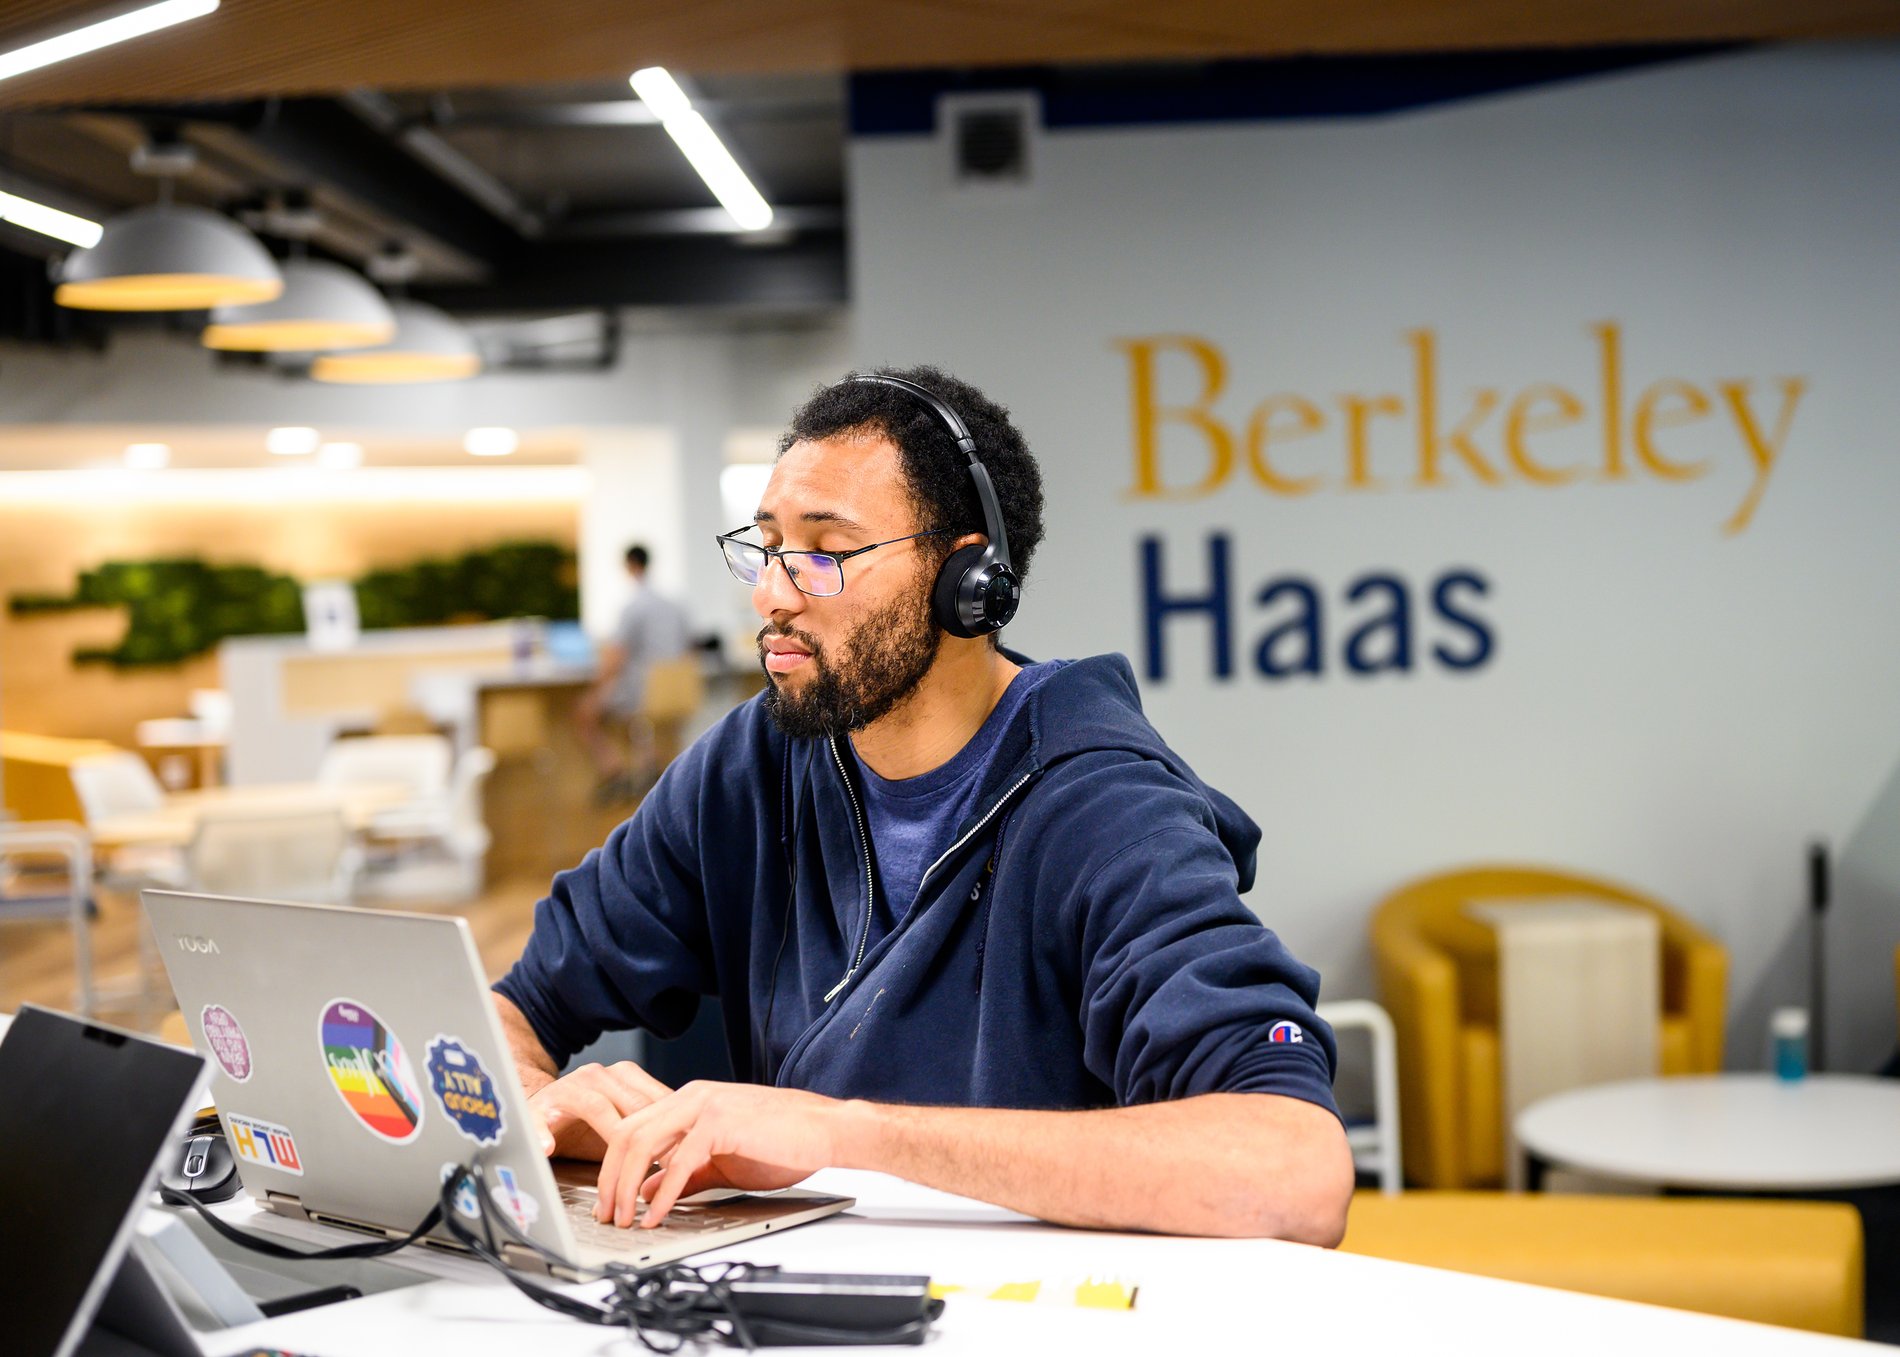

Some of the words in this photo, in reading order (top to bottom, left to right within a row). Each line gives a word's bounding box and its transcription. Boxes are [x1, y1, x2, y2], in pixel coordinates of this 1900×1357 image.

[1112, 320, 1808, 537] Berkeley
[1138, 530, 1498, 684] Haas
[443, 1091, 497, 1119] PROUD
[444, 1071, 482, 1096] ALLY
[231, 1123, 301, 1170] MLH
